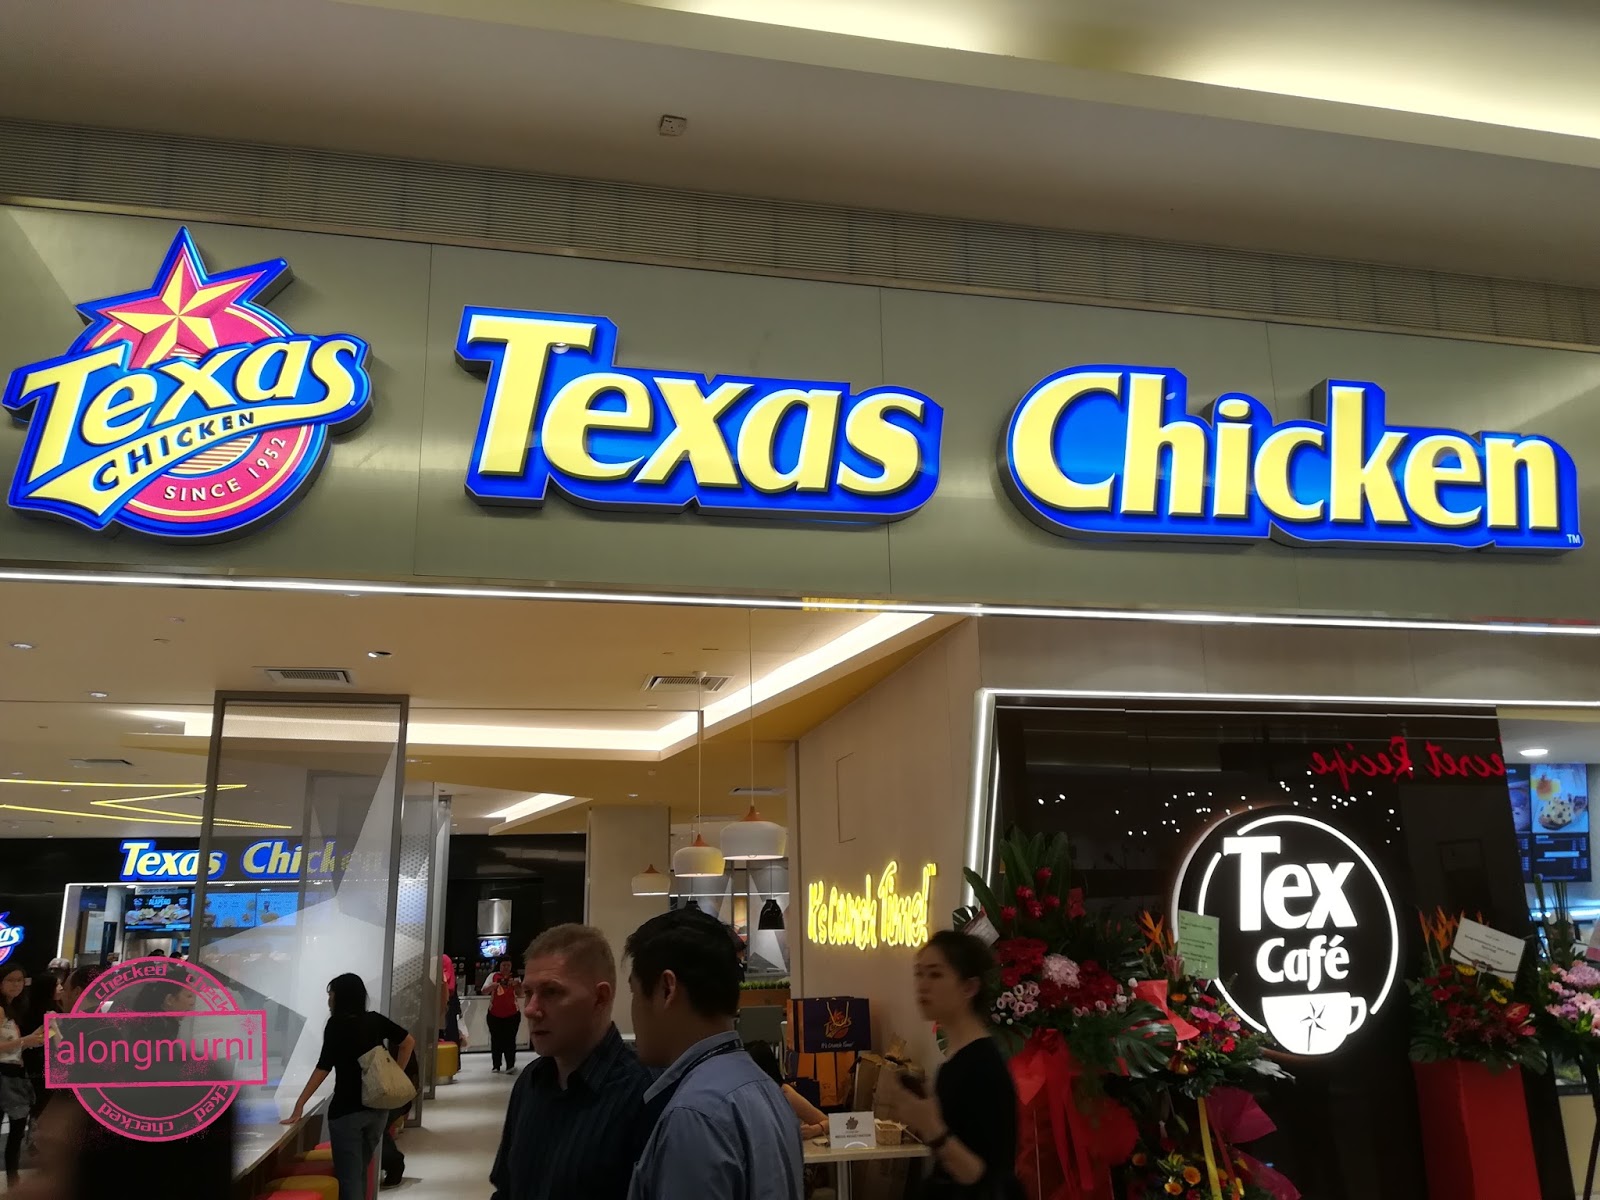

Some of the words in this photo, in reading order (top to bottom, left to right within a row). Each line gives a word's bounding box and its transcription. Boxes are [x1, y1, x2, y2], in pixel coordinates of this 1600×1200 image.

[20, 338, 359, 485] Texas
[91, 411, 255, 492] CHICKEN
[467, 314, 925, 496] Texas
[1011, 371, 1560, 532] Chicken
[163, 477, 242, 502] SINCE
[247, 436, 287, 479] 1952
[121, 842, 222, 876] Texas
[1223, 835, 1358, 932] Tex
[1255, 934, 1351, 992] Café
